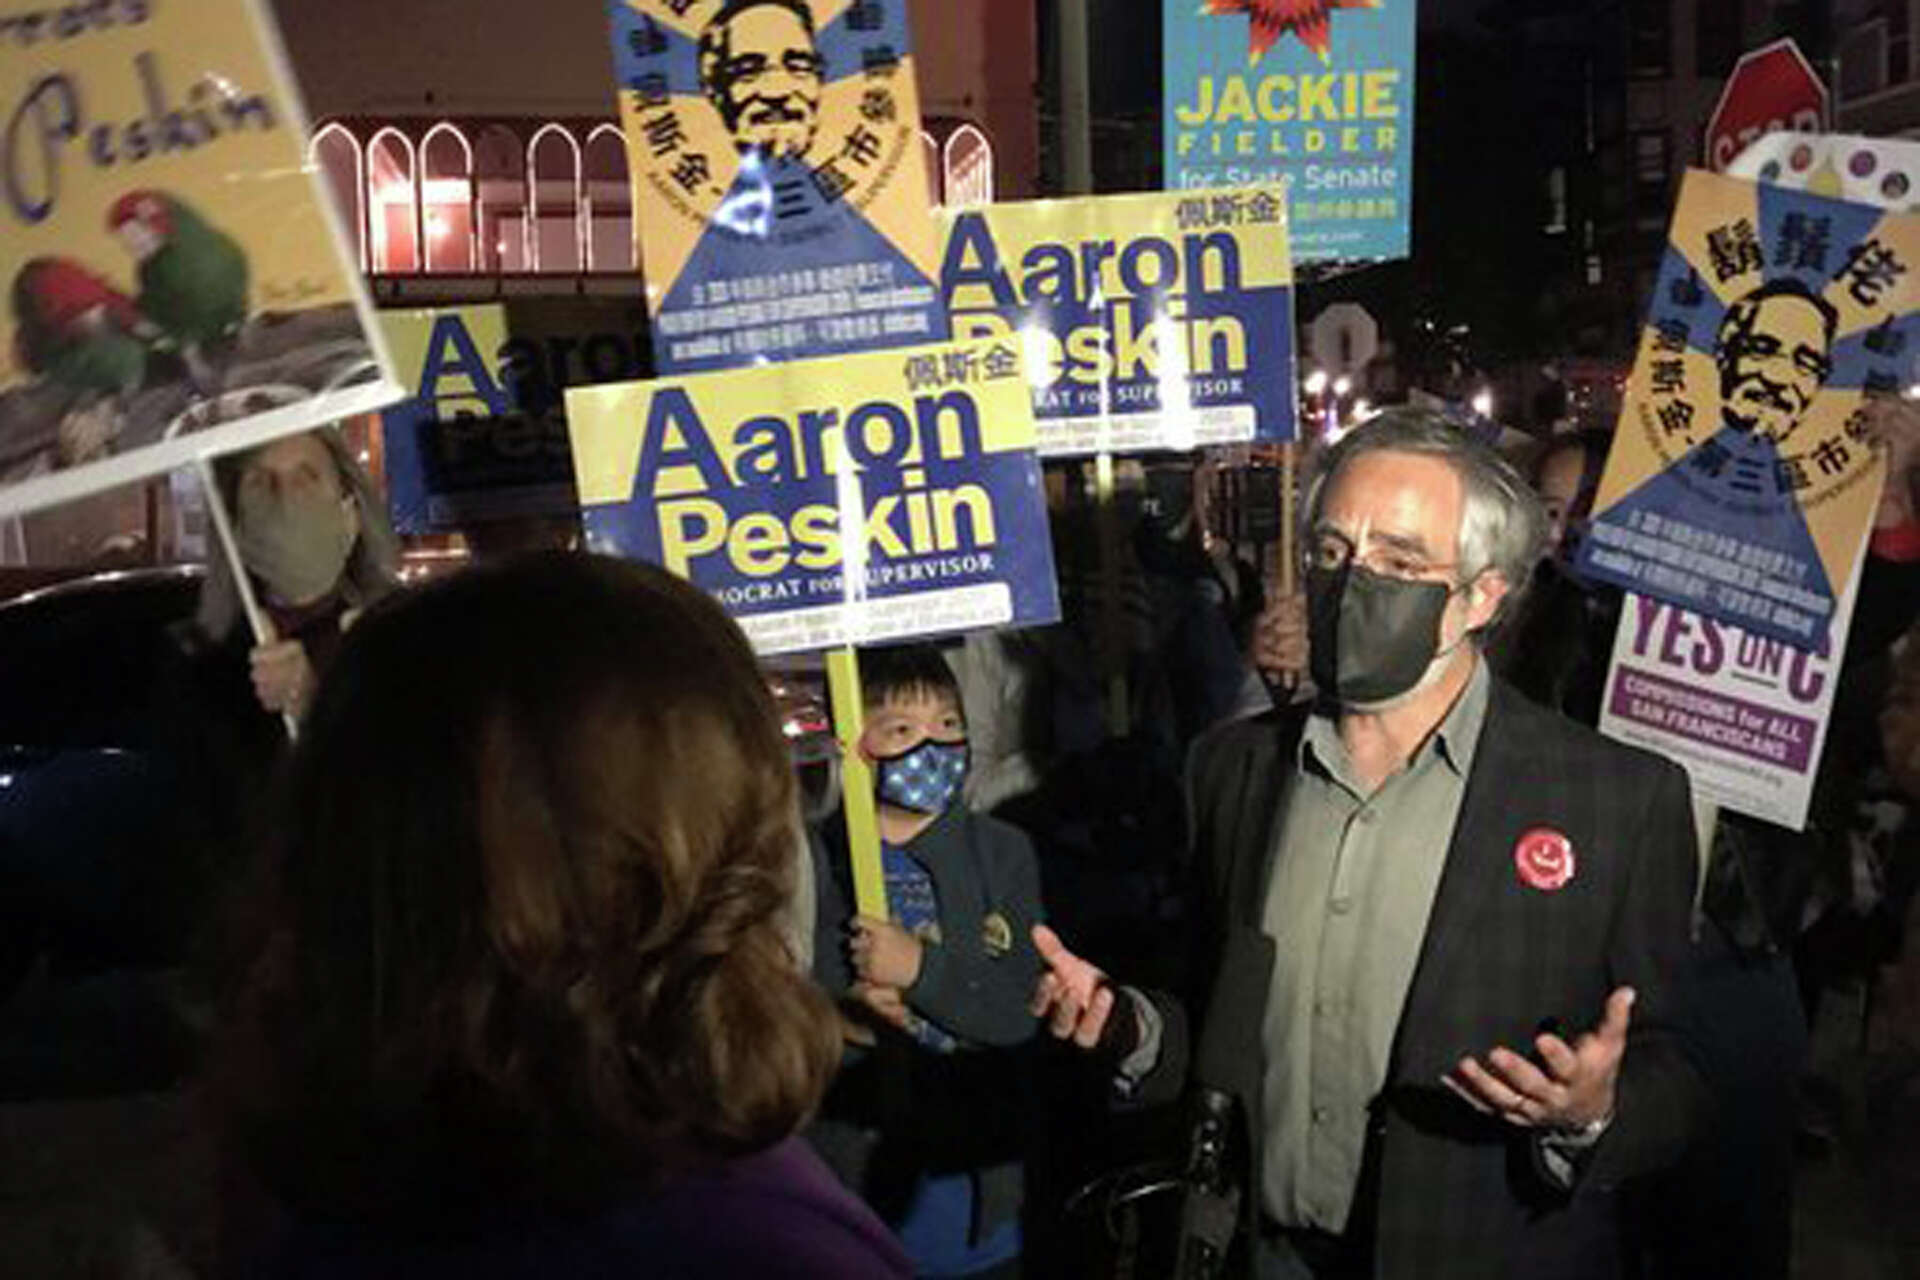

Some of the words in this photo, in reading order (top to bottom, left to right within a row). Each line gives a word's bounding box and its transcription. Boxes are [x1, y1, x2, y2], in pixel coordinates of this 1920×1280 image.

[1175, 70, 1399, 122] JACKIE
[1177, 126, 1397, 155] FIELDER
[1225, 168, 1295, 190] State
[1304, 164, 1397, 189] Senate
[940, 211, 1241, 313] Aaron
[418, 313, 655, 415] Aaro
[632, 385, 983, 502] Aaron
[655, 465, 997, 582] Peskin
[862, 554, 994, 587] UPERVISOR
[1633, 595, 1724, 675] YES
[1767, 717, 1802, 744] ALL
